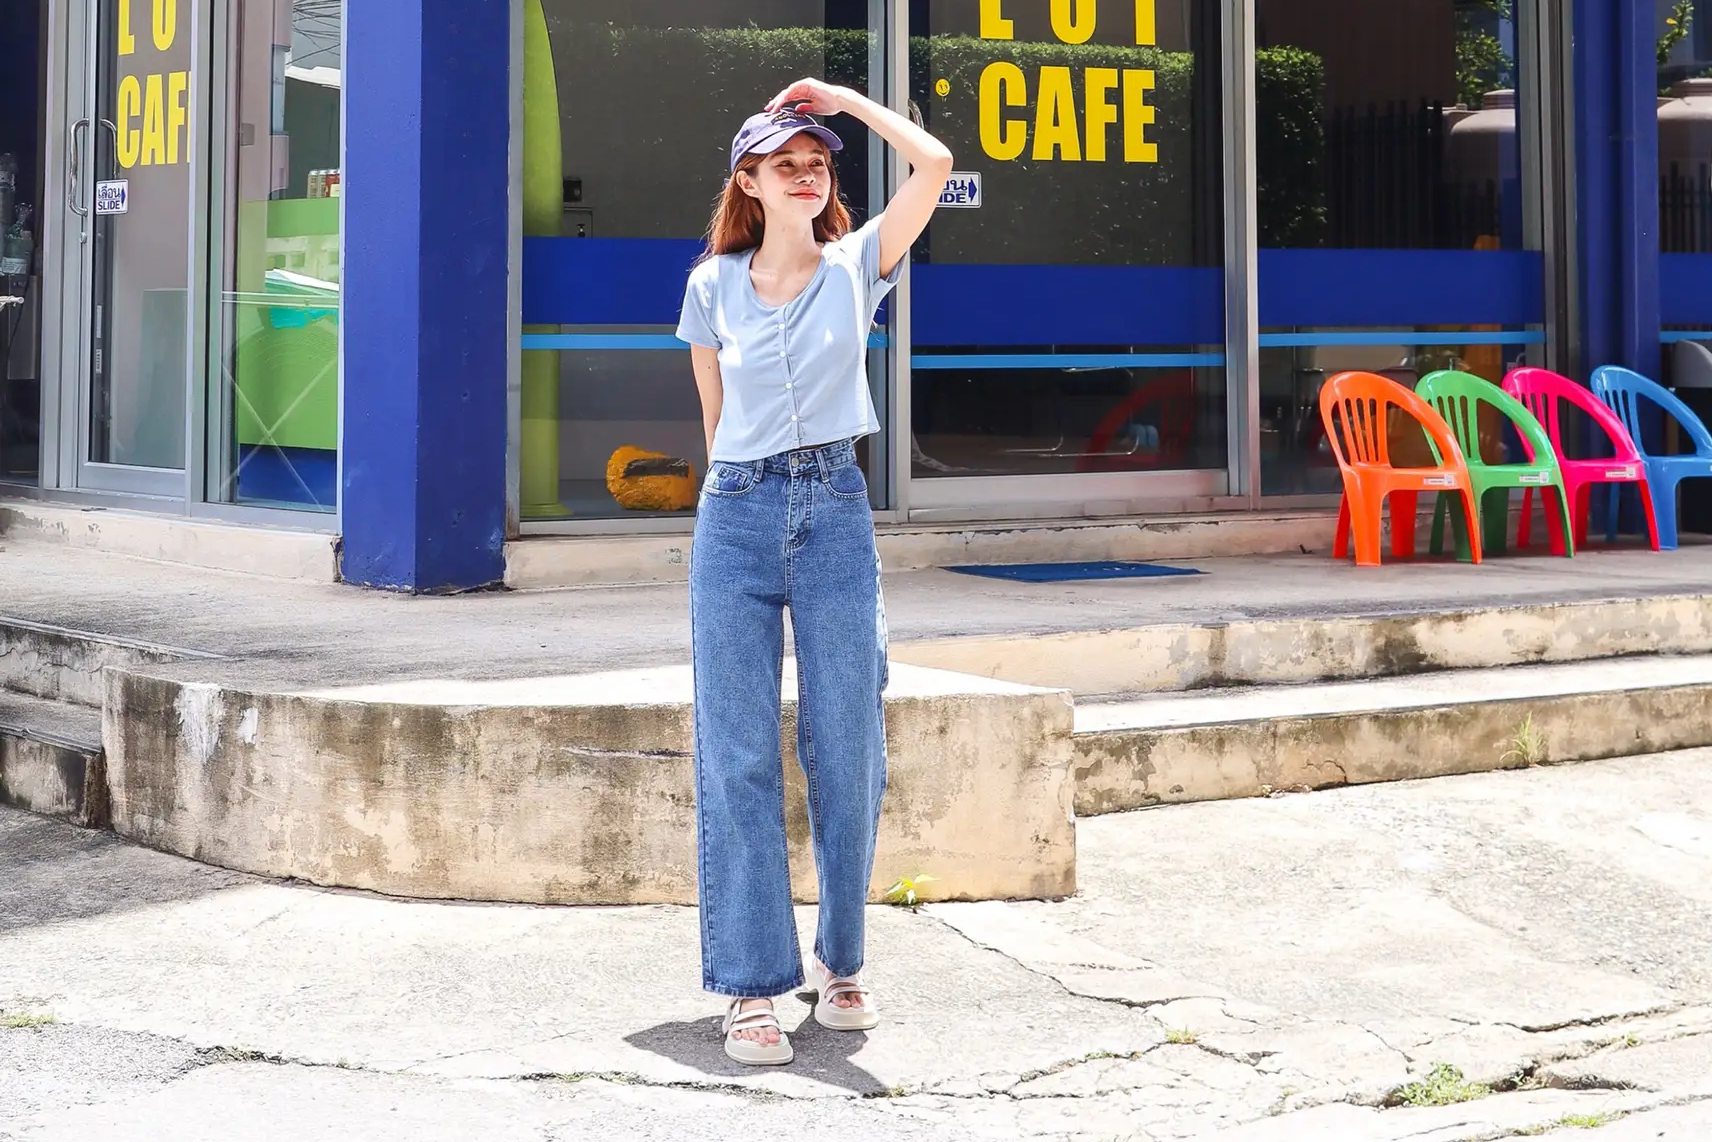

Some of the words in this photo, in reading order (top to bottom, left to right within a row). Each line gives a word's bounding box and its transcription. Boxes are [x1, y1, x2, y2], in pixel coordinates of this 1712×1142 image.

[117, 71, 191, 168] CAF
[978, 61, 1158, 163] CAFE
[98, 200, 121, 210] SLIDE
[939, 192, 967, 203] IDE
